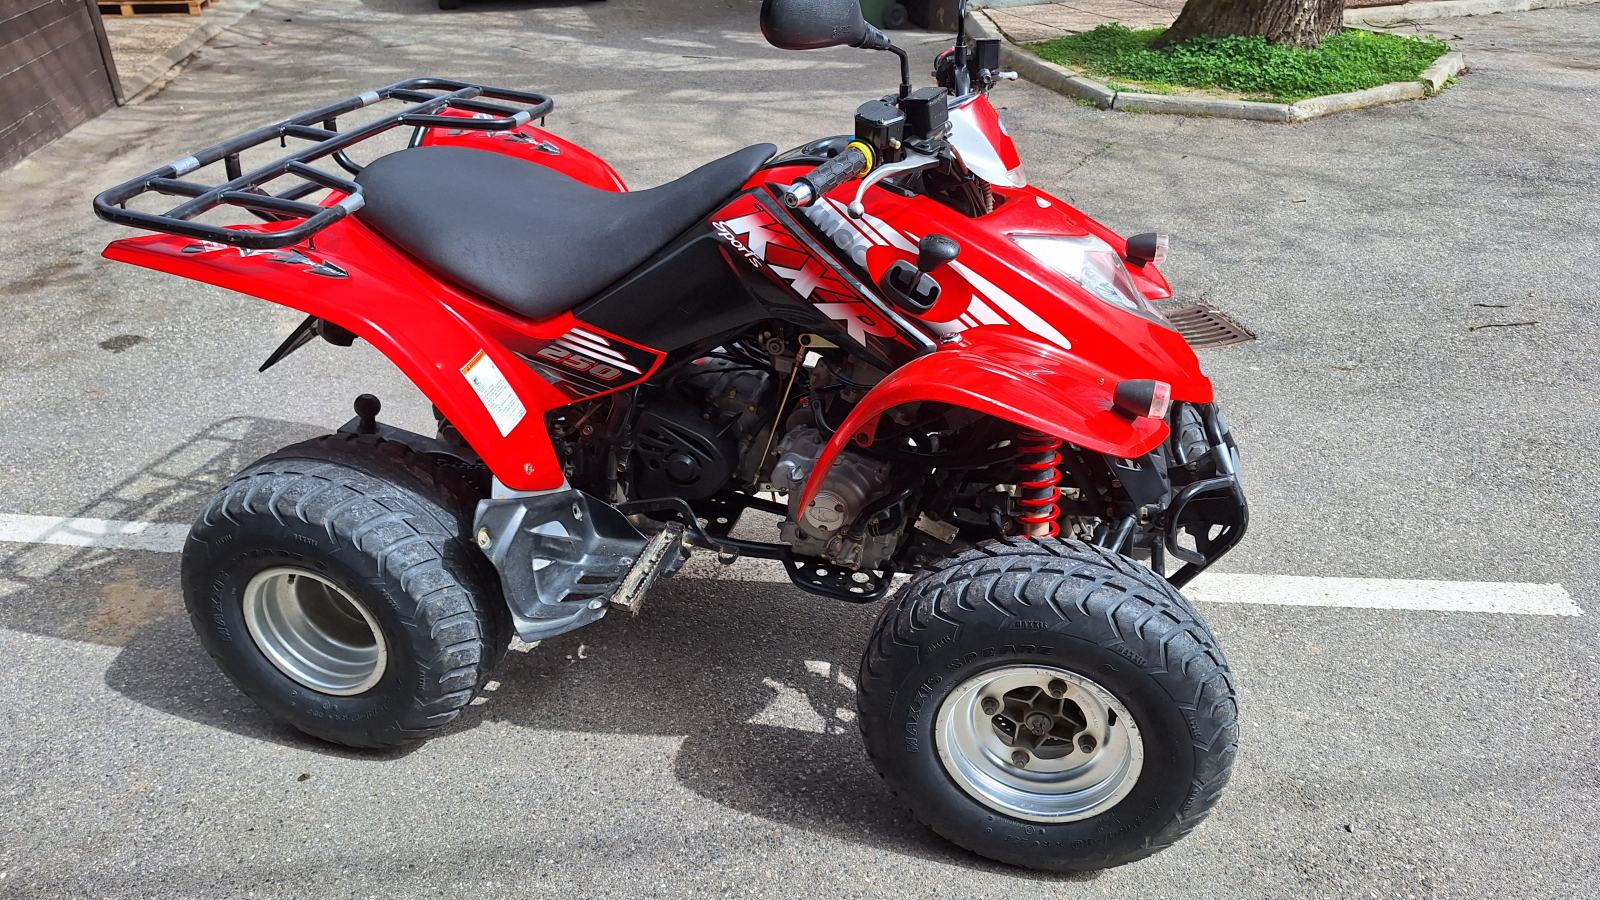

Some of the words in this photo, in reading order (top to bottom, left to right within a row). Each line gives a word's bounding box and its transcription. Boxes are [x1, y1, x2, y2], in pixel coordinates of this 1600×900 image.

[712, 220, 763, 269] Sports
[722, 203, 898, 348] KXR
[536, 345, 623, 381] 250
